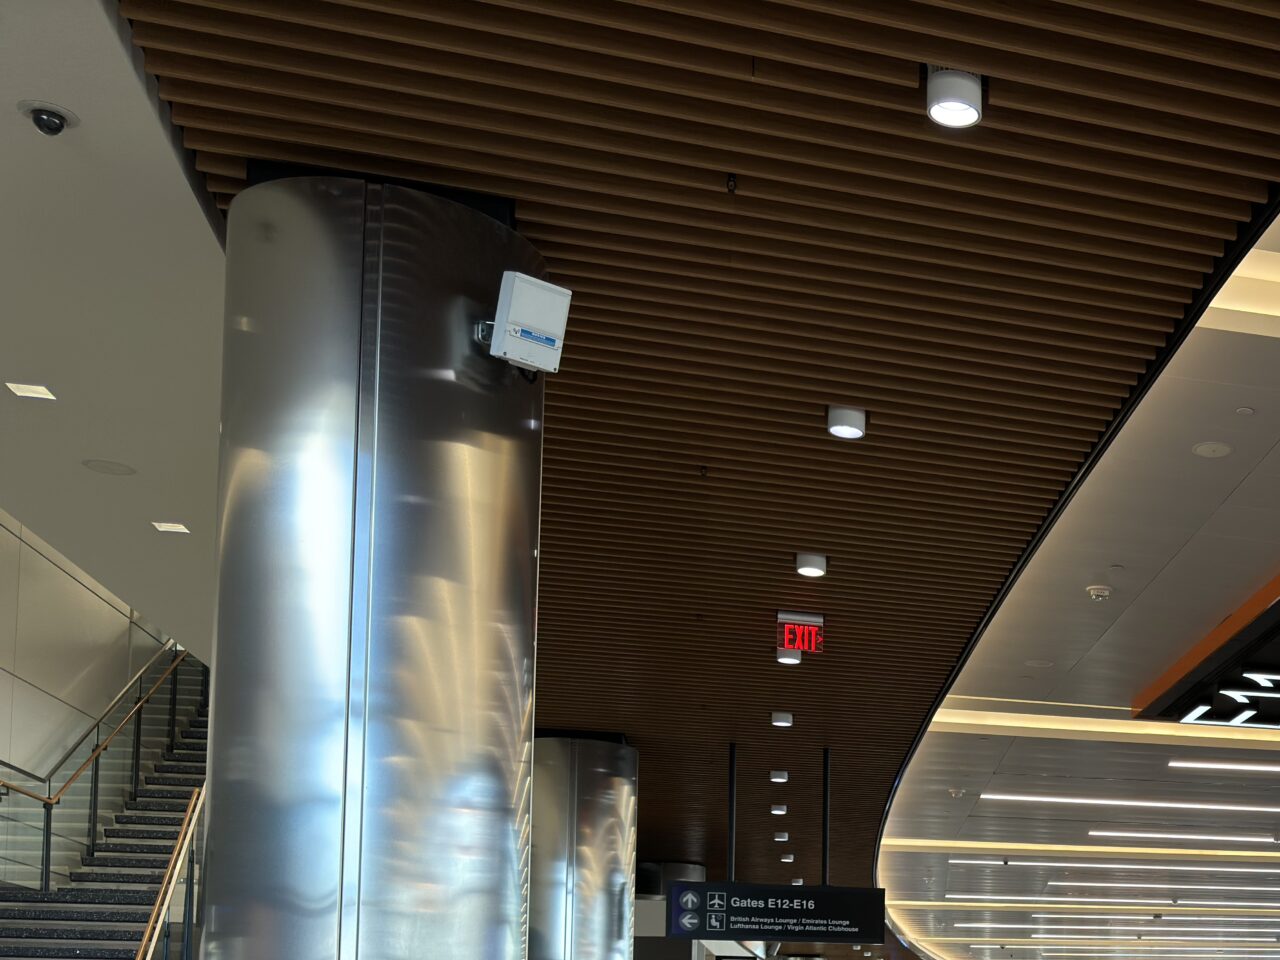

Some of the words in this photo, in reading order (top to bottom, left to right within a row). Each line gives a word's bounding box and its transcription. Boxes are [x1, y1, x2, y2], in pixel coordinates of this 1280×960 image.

[784, 623, 819, 652] EXIT
[730, 897, 765, 908] Gates
[768, 898, 815, 910] E12-E16
[787, 924, 804, 932] Virgin
